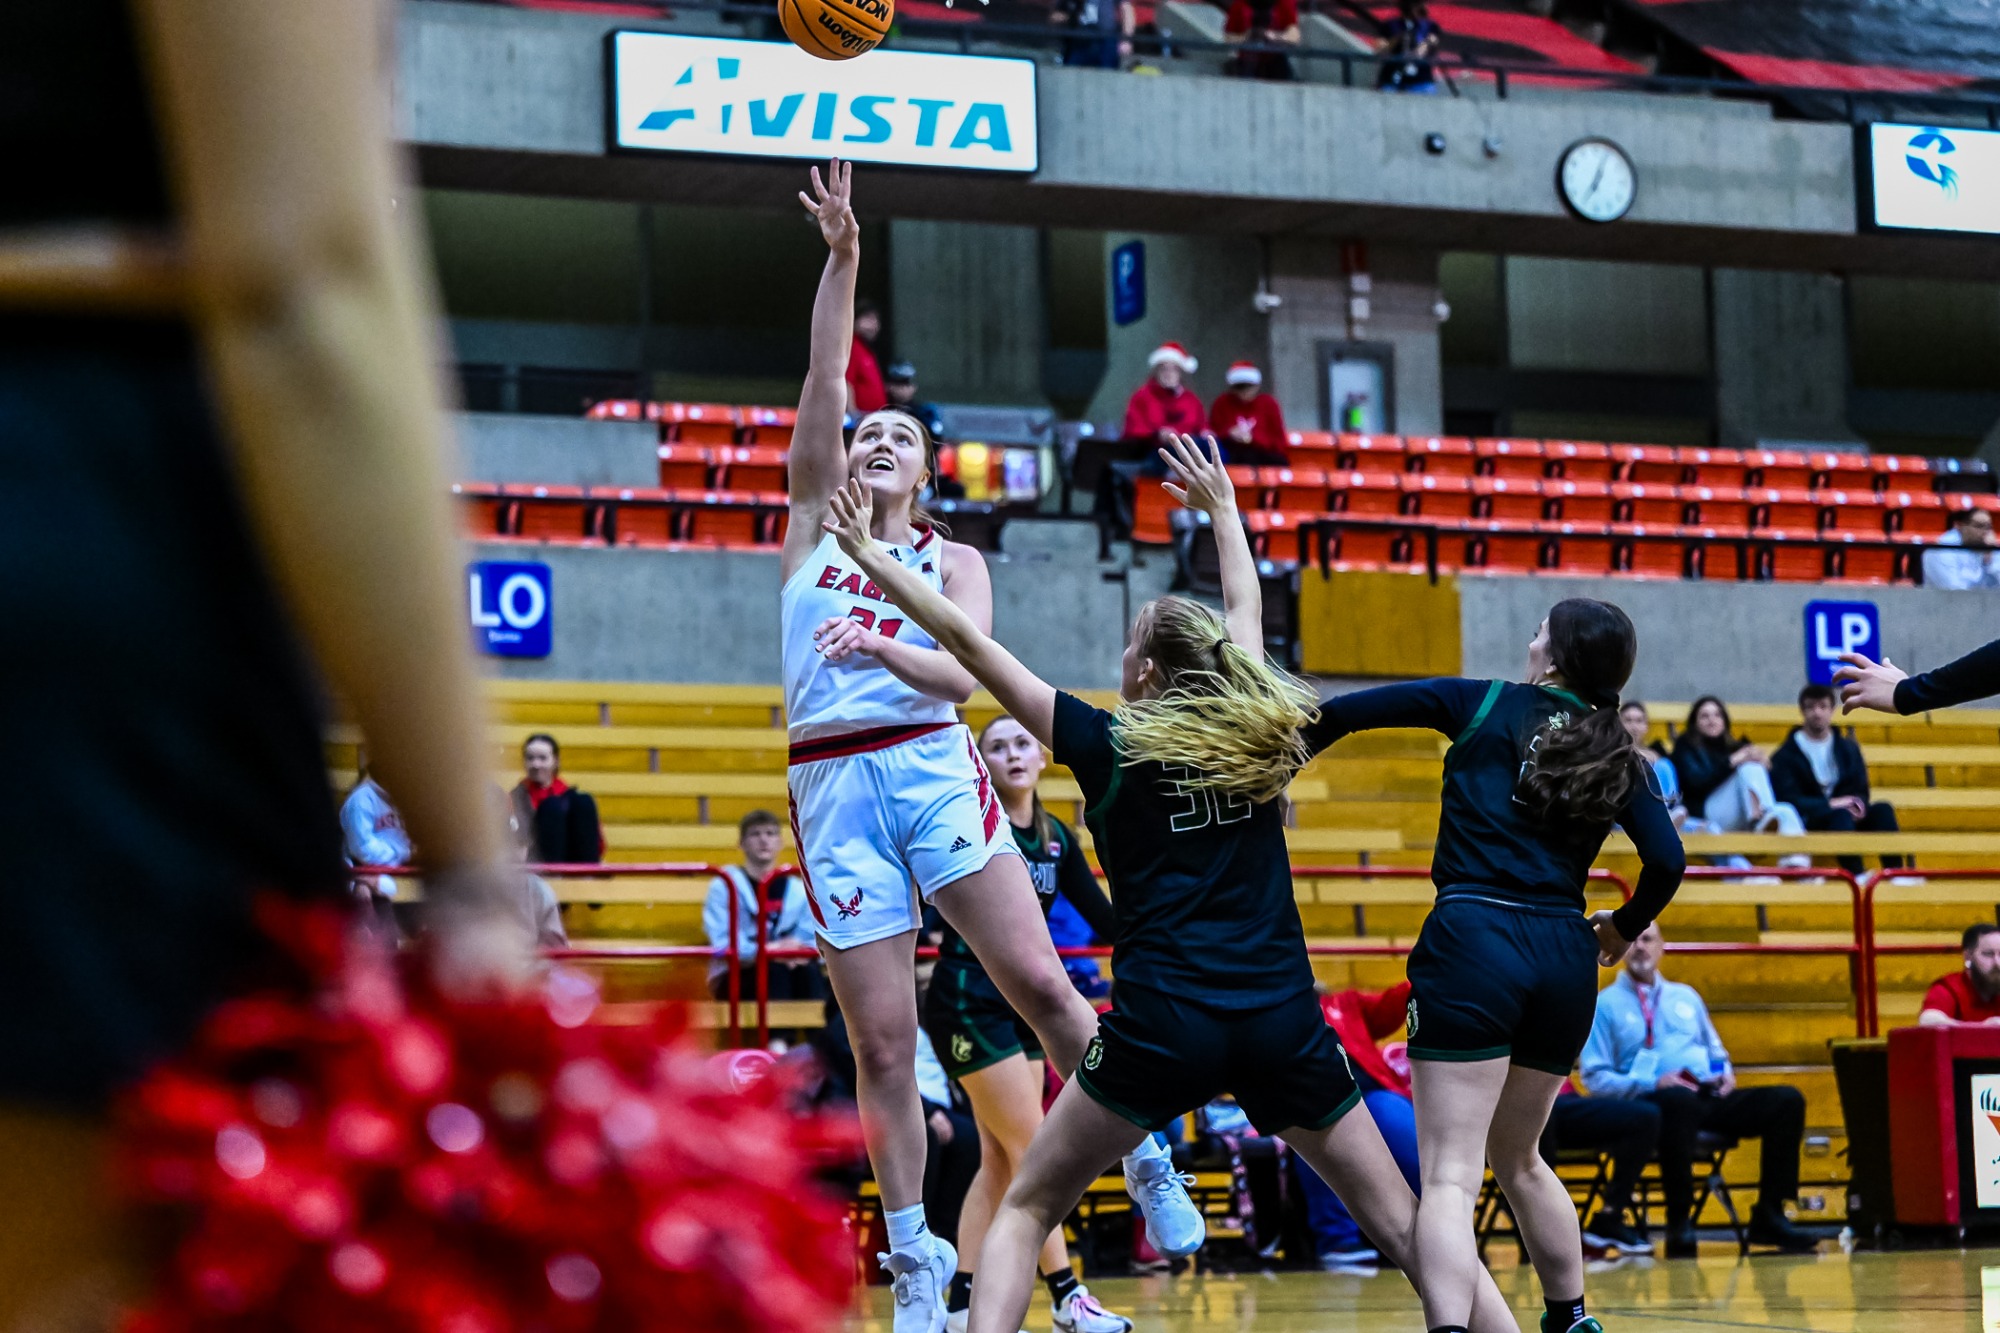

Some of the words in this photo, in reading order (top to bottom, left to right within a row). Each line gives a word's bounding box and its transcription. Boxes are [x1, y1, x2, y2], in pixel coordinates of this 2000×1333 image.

[818, 10, 877, 54] Wilson
[843, 0, 889, 22] NCA
[638, 57, 1012, 152] AVISTA
[470, 572, 546, 629] LO
[815, 565, 897, 606] EAG
[1815, 611, 1872, 660] LP
